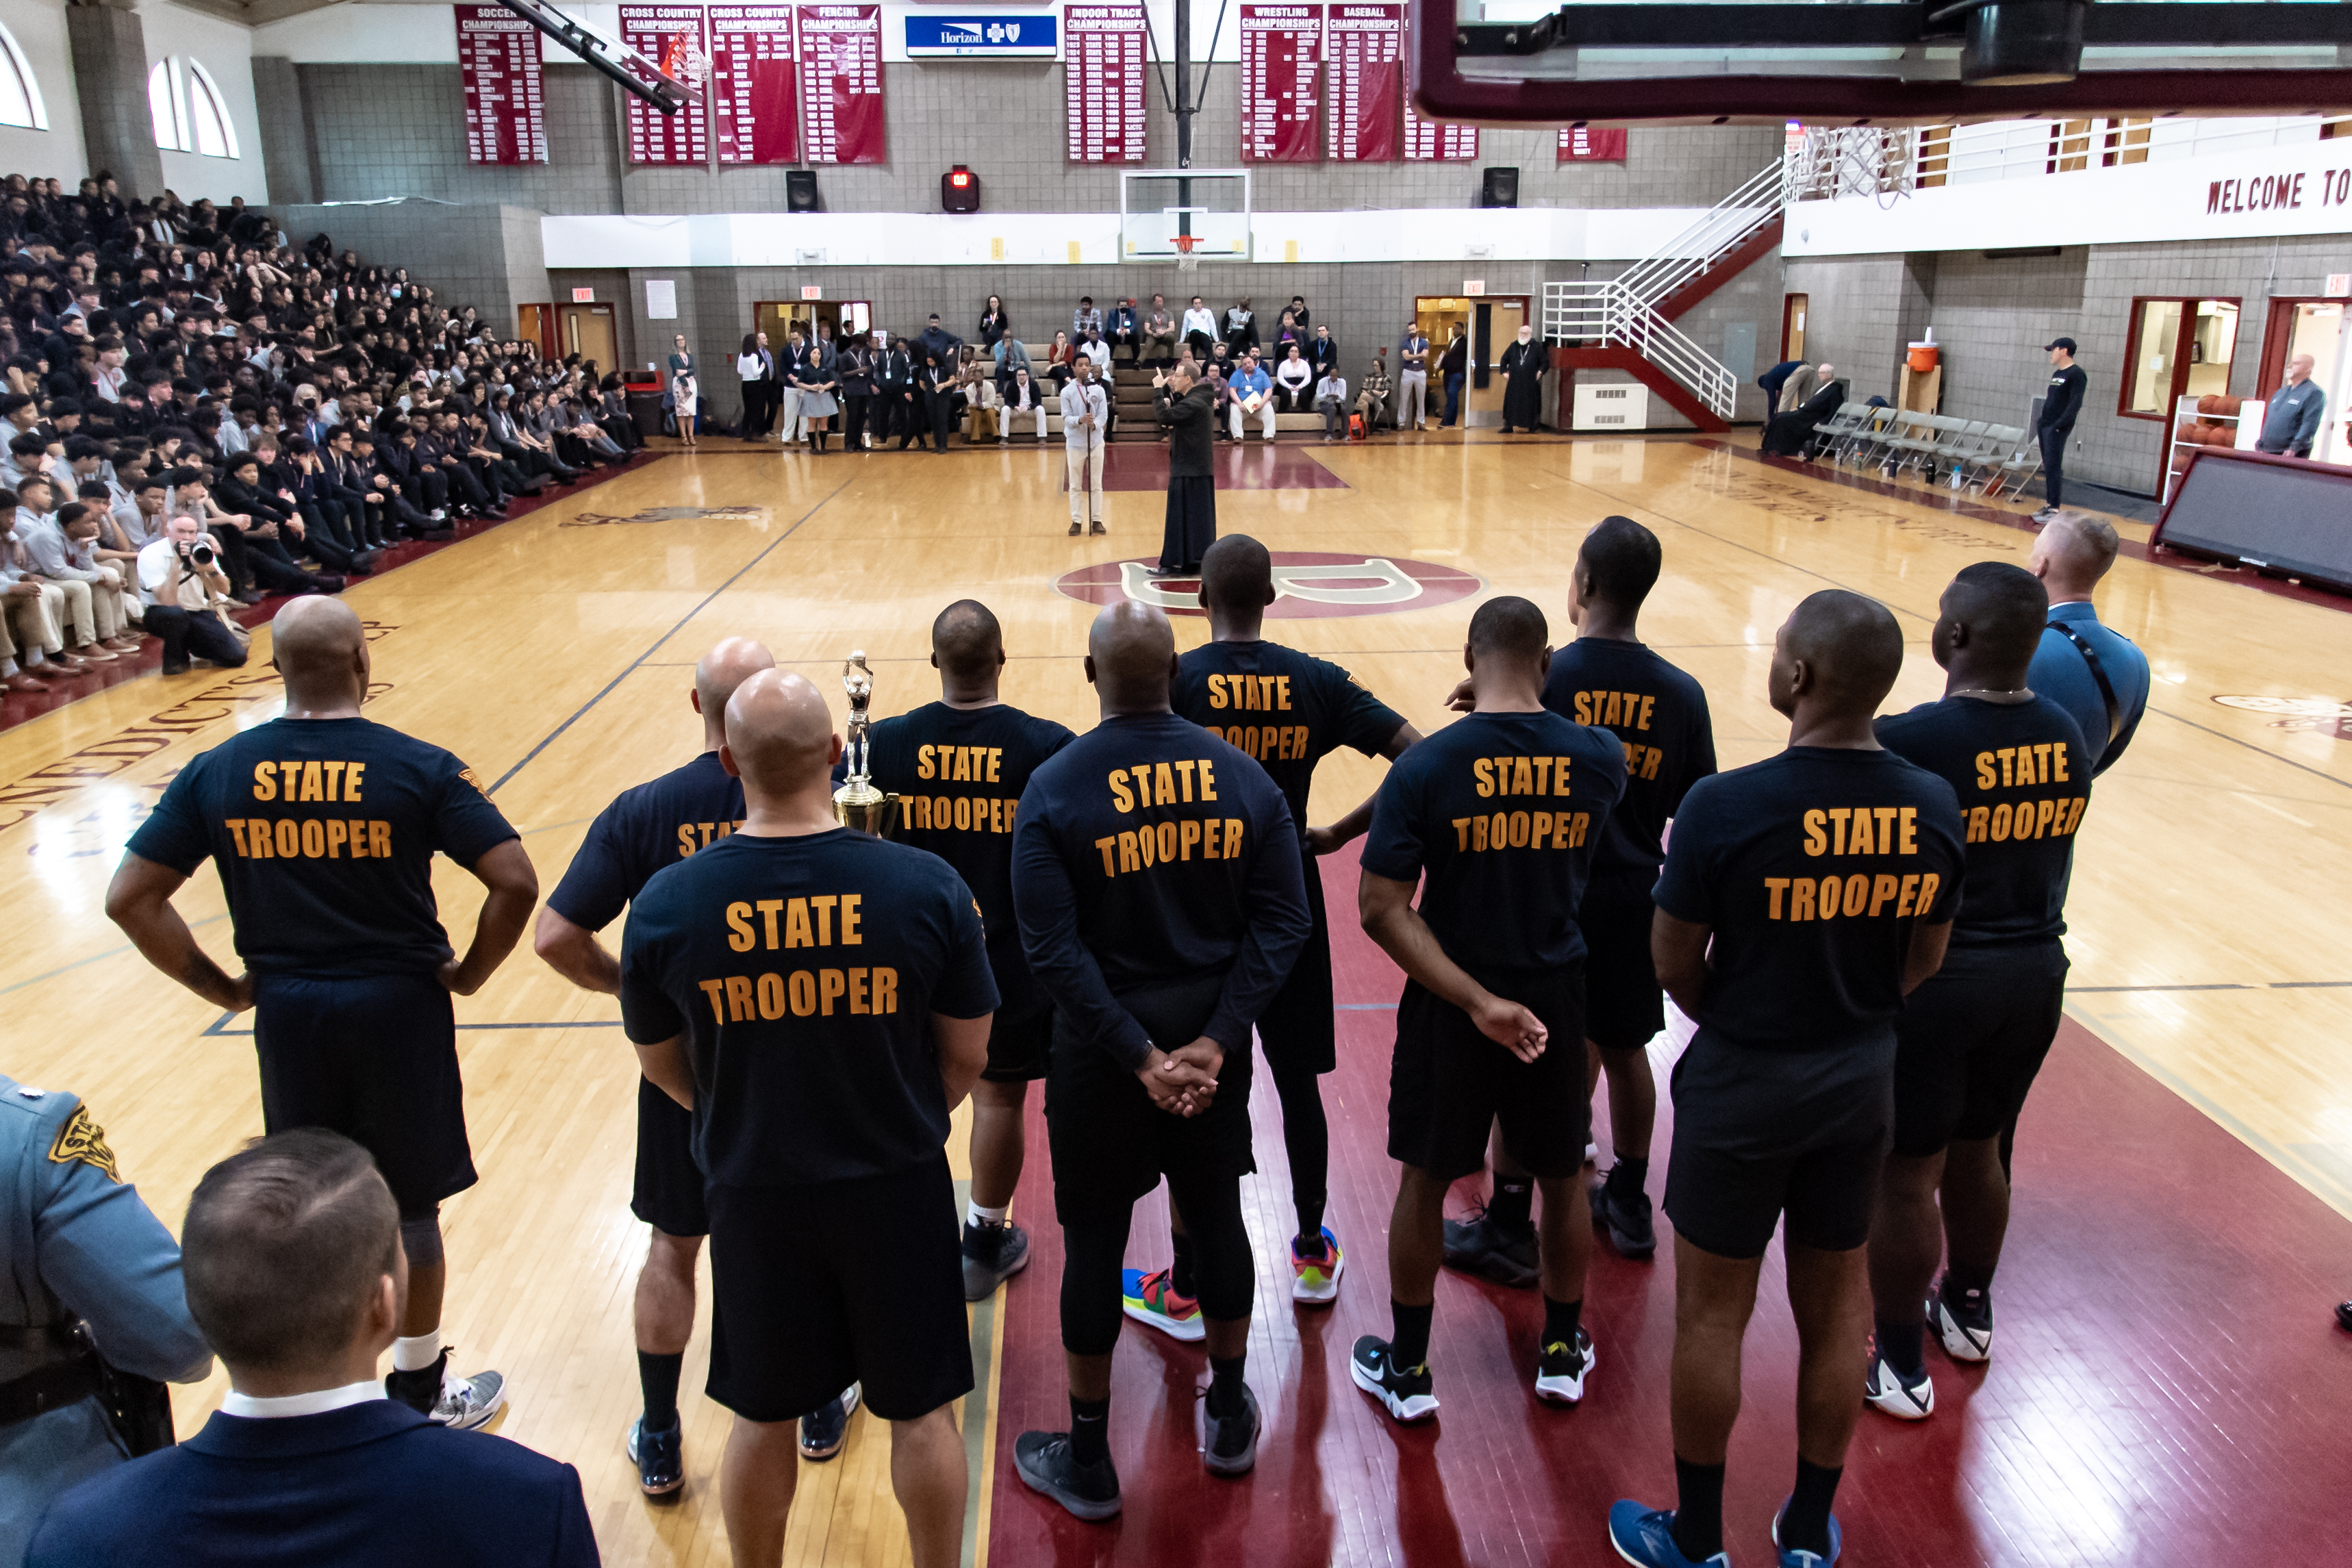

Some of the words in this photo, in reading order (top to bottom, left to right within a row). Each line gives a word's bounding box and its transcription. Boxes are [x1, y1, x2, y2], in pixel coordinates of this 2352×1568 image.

[622, 8, 654, 18] CROSS
[657, 8, 702, 18] COUNTRY
[710, 8, 744, 18] CROSS
[745, 8, 790, 18] COUNTRY
[819, 6, 859, 17] FENCING
[1072, 8, 1109, 18] INDOOR
[1109, 8, 1142, 18] TRACK
[1254, 8, 1308, 17] WRESTLING
[1343, 8, 1385, 17] BASEBALL
[627, 20, 698, 30] CHAMPIONSHIPS
[716, 20, 787, 29] CHAMPIONSHIPS
[801, 18, 878, 29] CHAMPIONSHIPS
[1067, 19, 1146, 29] CHAMPIONSHIPS
[1241, 18, 1320, 28] CHAMPIONSHIPS
[1329, 18, 1399, 29] CHAMPIONSHIPS
[941, 31, 983, 43] Horizon
[2206, 173, 2305, 215] WELCOME
[2323, 169, 2351, 207] TO
[1467, 283, 1481, 294] EXIT
[2330, 277, 2346, 294] EXIT
[576, 290, 590, 301] EXIT
[805, 288, 818, 299] EXIT
[1207, 674, 1291, 711] STATE
[1574, 690, 1656, 731] STATE
[918, 744, 1002, 783] STATE
[1975, 742, 2070, 790] STATE
[253, 761, 366, 802] STATE
[1474, 756, 1571, 798] STATE
[1108, 759, 1217, 813] STATE
[225, 818, 392, 859] TROOPER
[1452, 811, 1590, 853] TROOPER
[1804, 807, 1918, 857] STATE
[1095, 818, 1243, 878] TROOPER
[1765, 873, 1940, 923] TROOPER
[726, 894, 863, 952] STATE
[698, 967, 898, 1026] TROOPER
